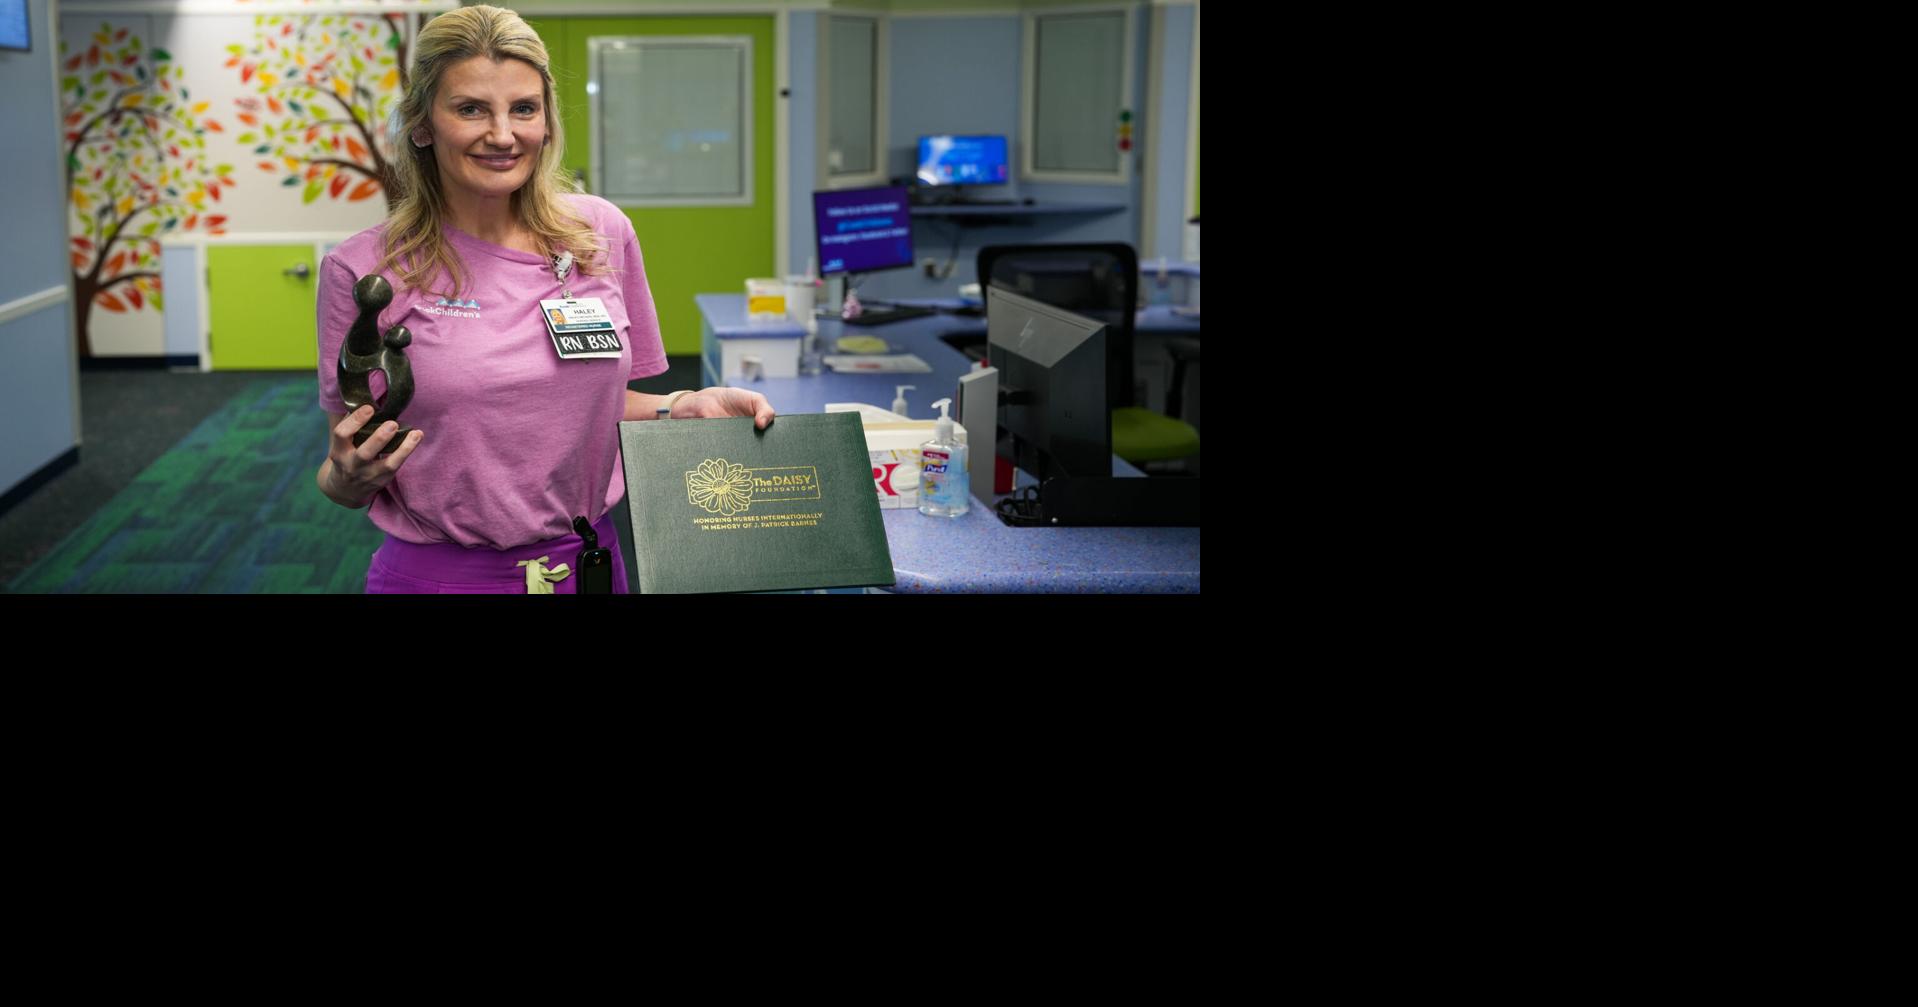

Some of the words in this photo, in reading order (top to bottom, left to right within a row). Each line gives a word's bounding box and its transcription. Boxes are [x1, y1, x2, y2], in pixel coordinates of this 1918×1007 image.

[559, 335, 584, 351] RN
[586, 334, 620, 350] BSN
[752, 477, 772, 487] The
[773, 474, 811, 486] DAISY
[755, 485, 813, 493] FOUNDATION
[693, 517, 732, 525] HONORING
[733, 515, 760, 523] NURSES
[760, 512, 822, 522] INTERNATIONALLY
[761, 520, 789, 528] PATRICK
[790, 519, 817, 527] BARNES
